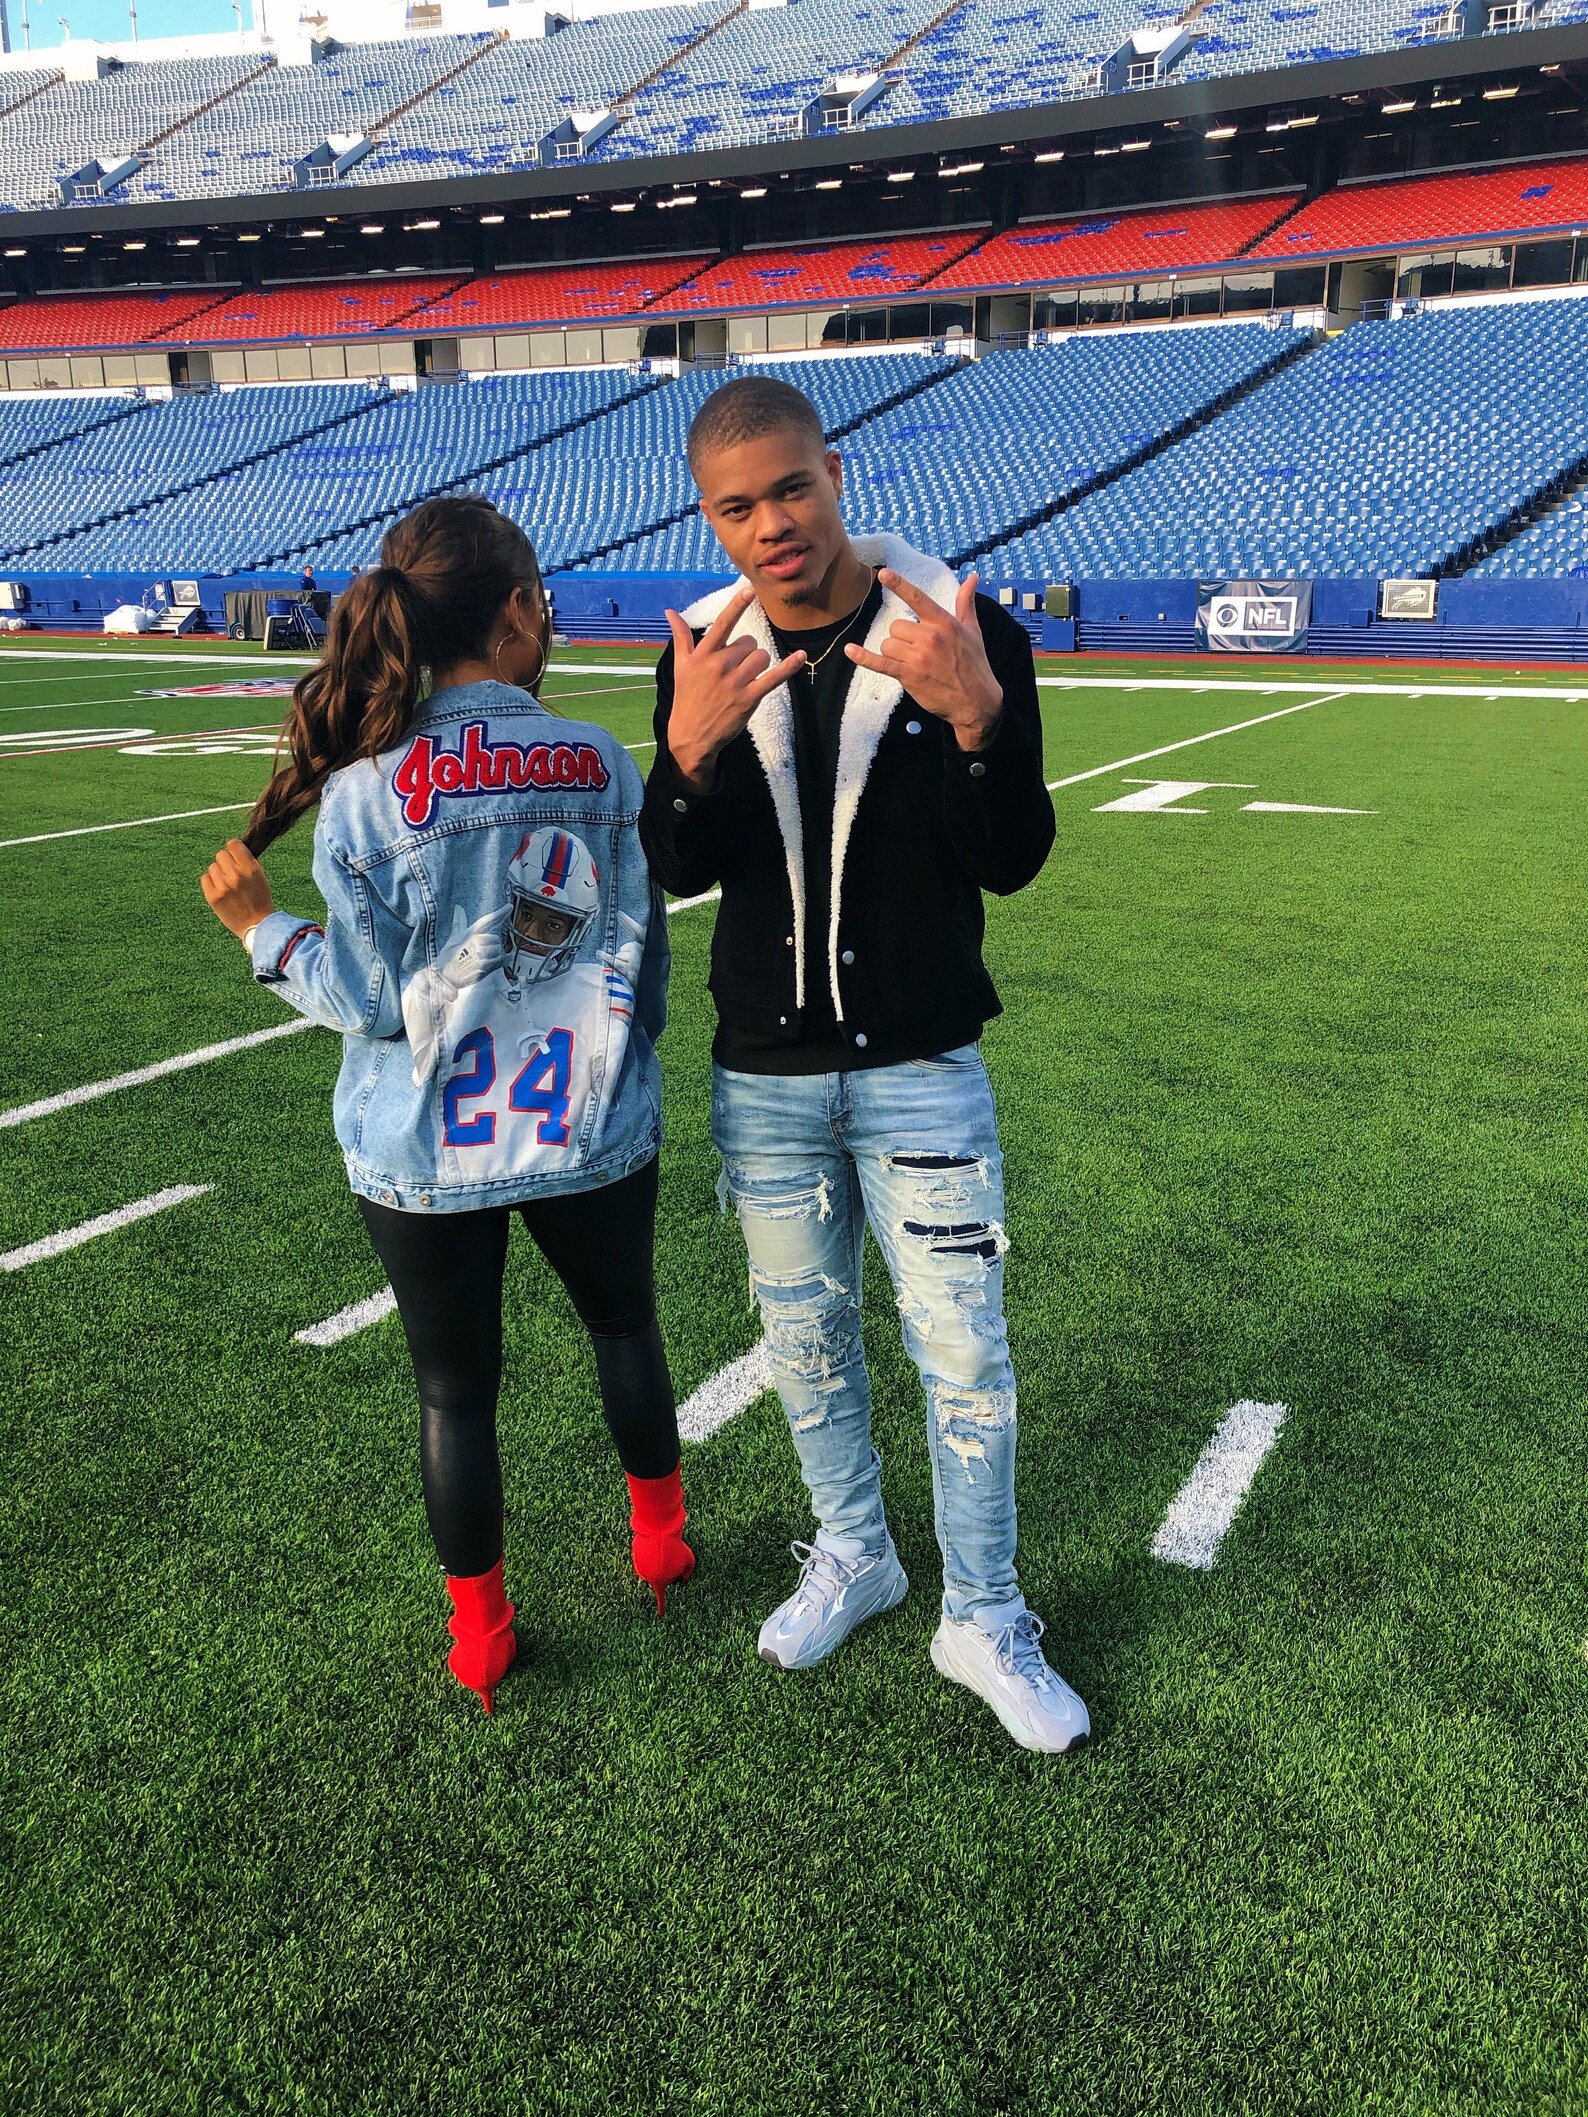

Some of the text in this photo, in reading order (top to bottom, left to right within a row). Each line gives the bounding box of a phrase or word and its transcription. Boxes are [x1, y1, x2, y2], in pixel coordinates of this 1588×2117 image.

[1248, 608, 1287, 625] NFL
[394, 722, 609, 827] Johnson
[442, 1025, 575, 1148] 24
